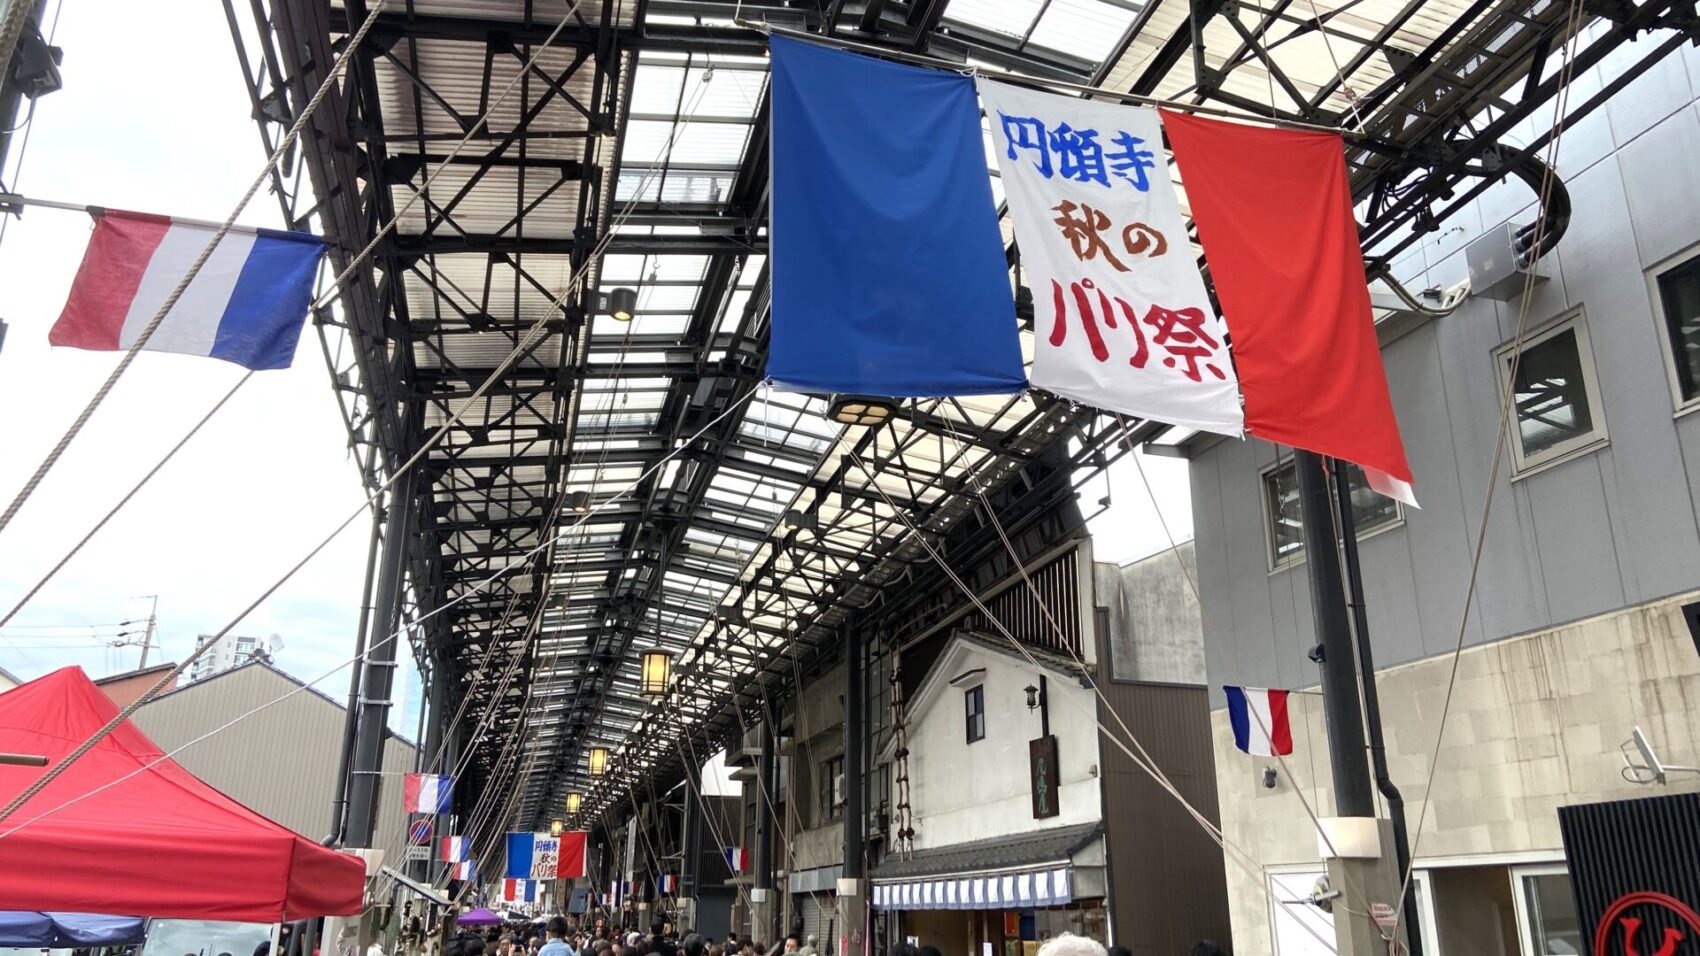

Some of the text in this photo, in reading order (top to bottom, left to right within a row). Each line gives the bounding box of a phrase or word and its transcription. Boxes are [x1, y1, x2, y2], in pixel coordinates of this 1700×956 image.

[997, 110, 1155, 192] 円頓寺
[1051, 200, 1168, 272] 秋の
[1049, 278, 1226, 382] パリ祭
[531, 863, 557, 877] パリ祭
